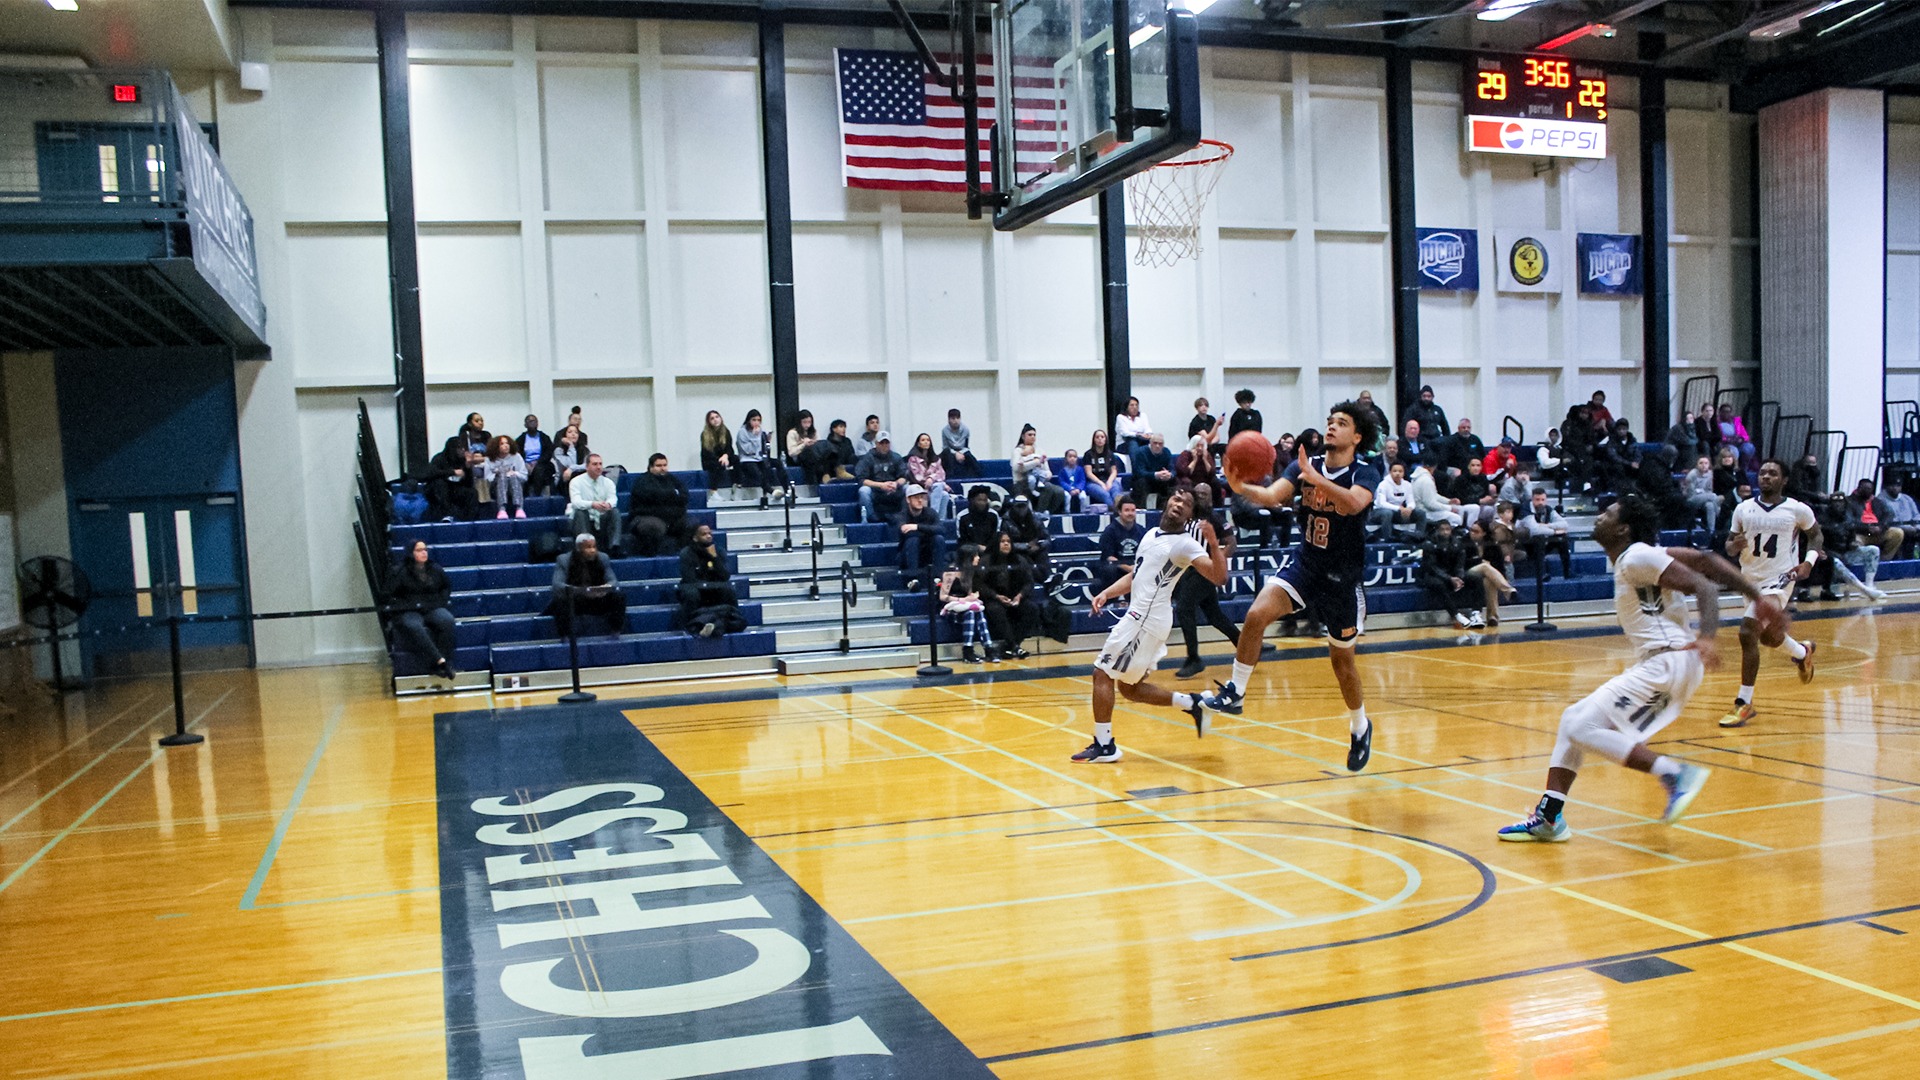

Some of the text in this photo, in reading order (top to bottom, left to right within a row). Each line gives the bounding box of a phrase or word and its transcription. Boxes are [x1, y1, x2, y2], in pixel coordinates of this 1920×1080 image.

[1478, 72, 1507, 100] 29
[1525, 59, 1570, 88] 3:56
[1579, 80, 1606, 107] 22
[1566, 101, 1574, 119] 1
[1531, 129, 1598, 149] PEPSI
[1418, 240, 1464, 270] NJCAA
[1589, 251, 1631, 281] NJCAA
[1305, 514, 1330, 549] 12
[1752, 533, 1778, 559] 14
